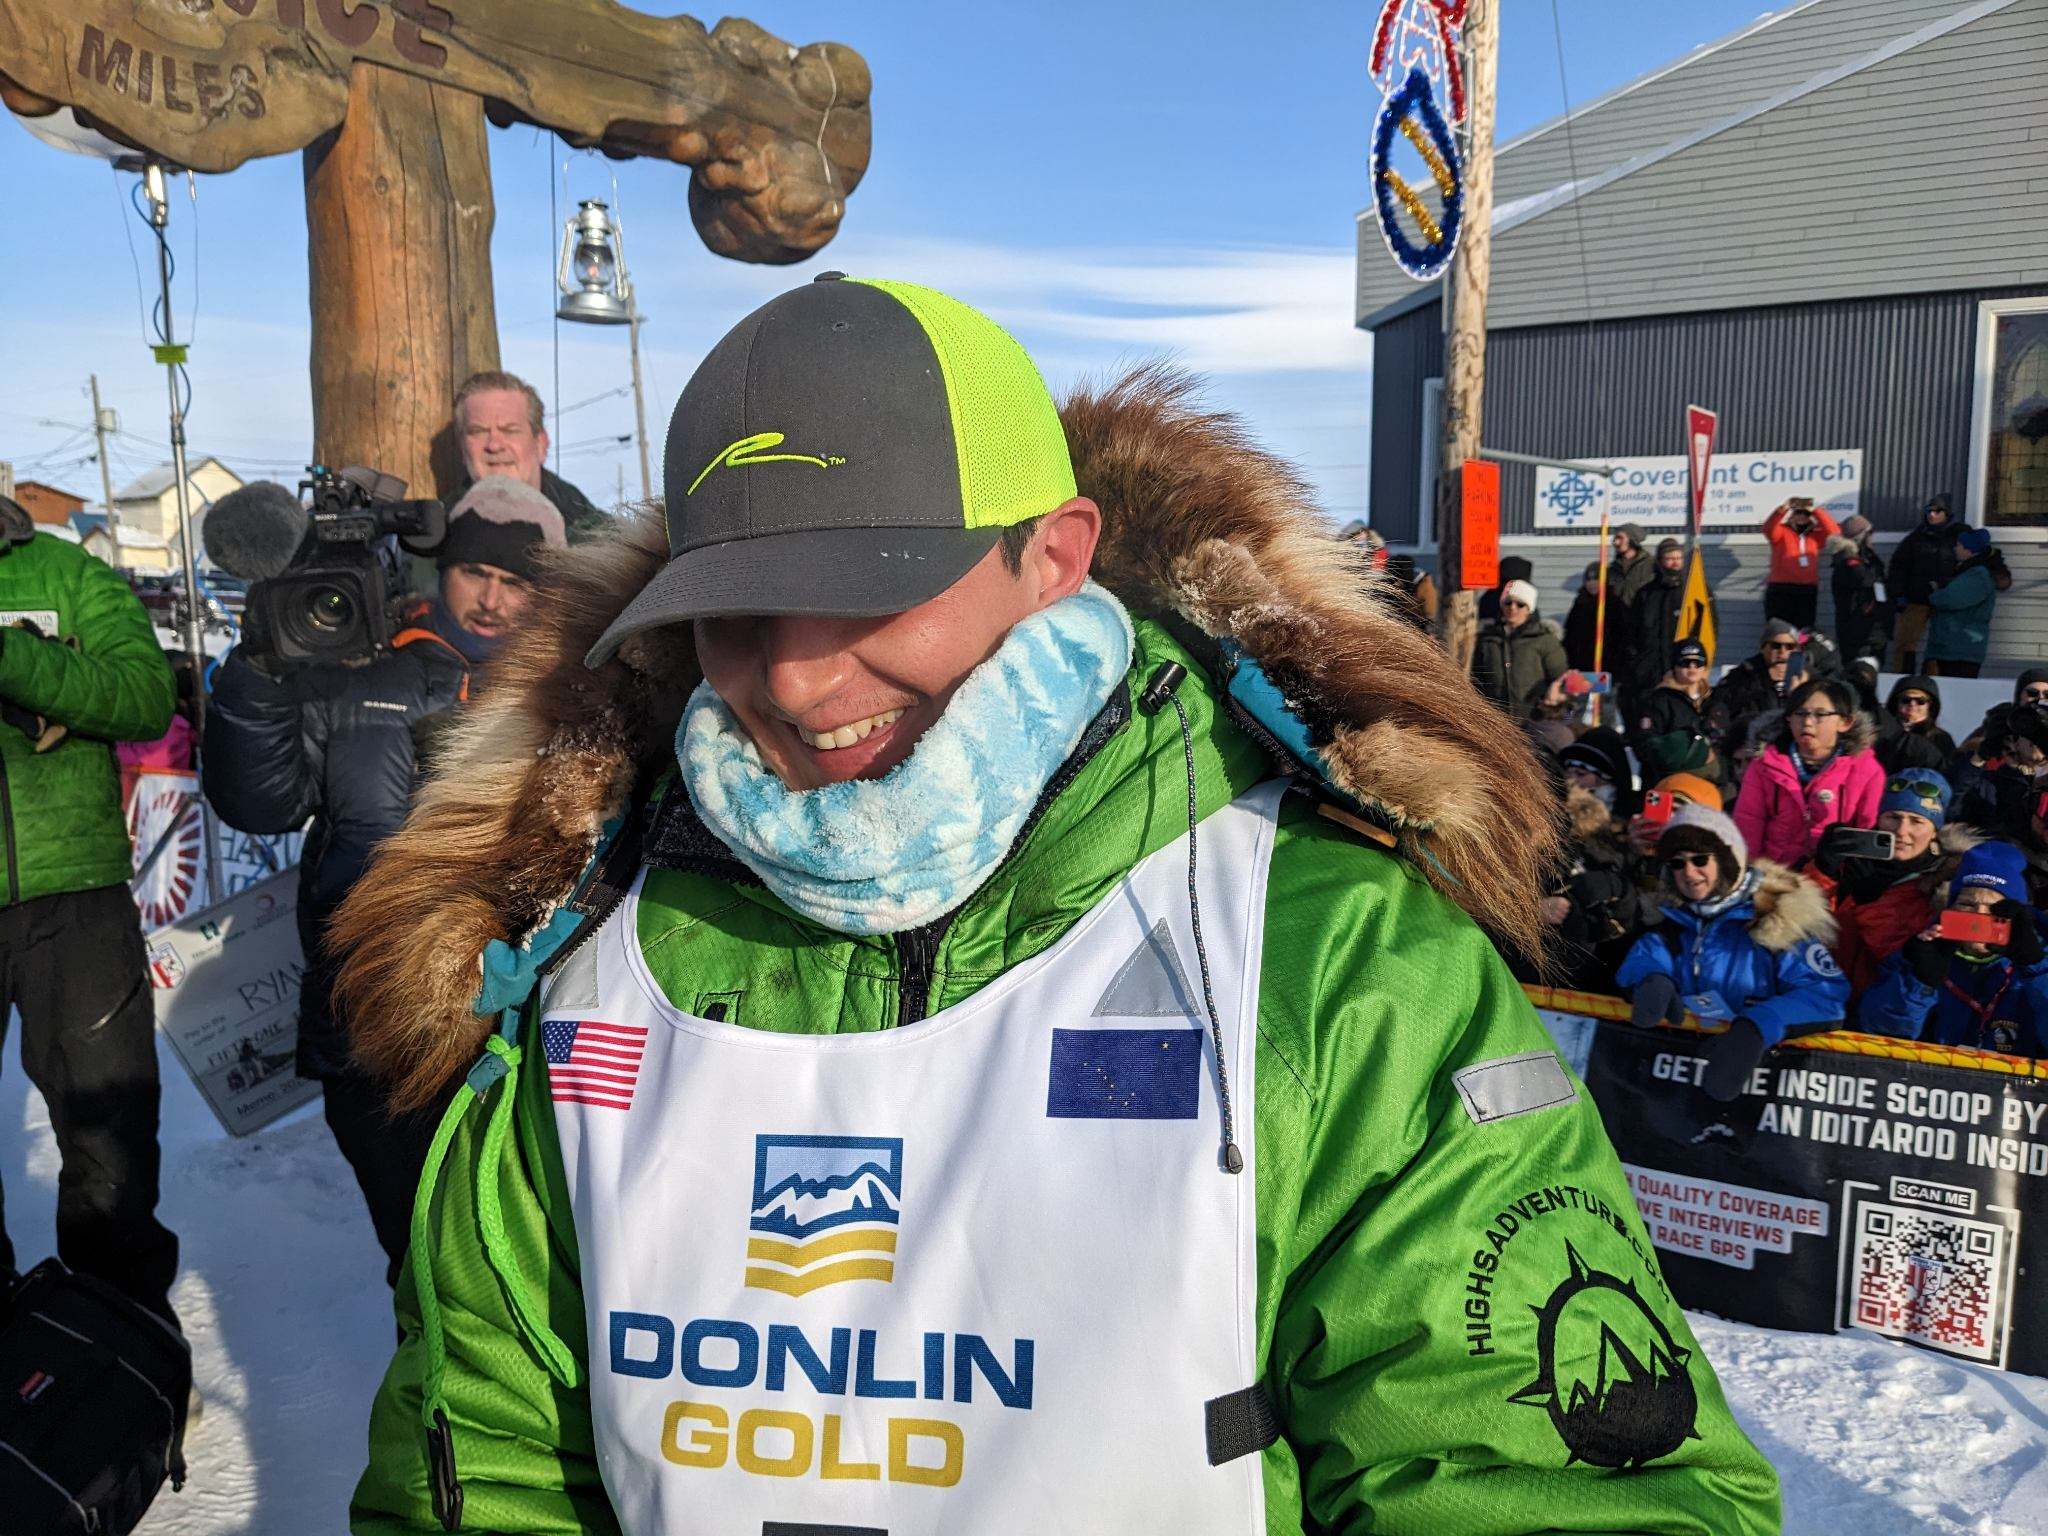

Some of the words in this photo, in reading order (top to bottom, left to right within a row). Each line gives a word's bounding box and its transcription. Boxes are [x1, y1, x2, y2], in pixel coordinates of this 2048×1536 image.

[77, 23, 266, 120] MILES
[1610, 463, 1739, 487] Covennt
[1748, 458, 1855, 483] Church
[1611, 491, 1654, 503] Sunday
[1727, 490, 1746, 499] am
[1611, 505, 1653, 516] Sunday
[1734, 504, 1754, 513] am
[1652, 1052, 1710, 1087] GET
[1776, 1068, 1878, 1110] INSIDE
[1886, 1082, 1991, 1125] SCOOP
[2002, 1097, 2048, 1135] BY
[1757, 1103, 1802, 1137] AN
[1811, 1110, 1957, 1161] IDITAROD
[1638, 1174, 1713, 1207] QUALITY
[1718, 1191, 1821, 1227] COVERAGE
[1896, 1183, 1942, 1202] SCAN
[1945, 1193, 1970, 1207] ME
[1656, 1225, 1704, 1251] RACE
[1710, 1239, 1746, 1262] GPS
[1668, 1206, 1784, 1245] INTERVIEWS
[609, 1310, 1035, 1410] DONLIN
[660, 1400, 965, 1488] GOLD
